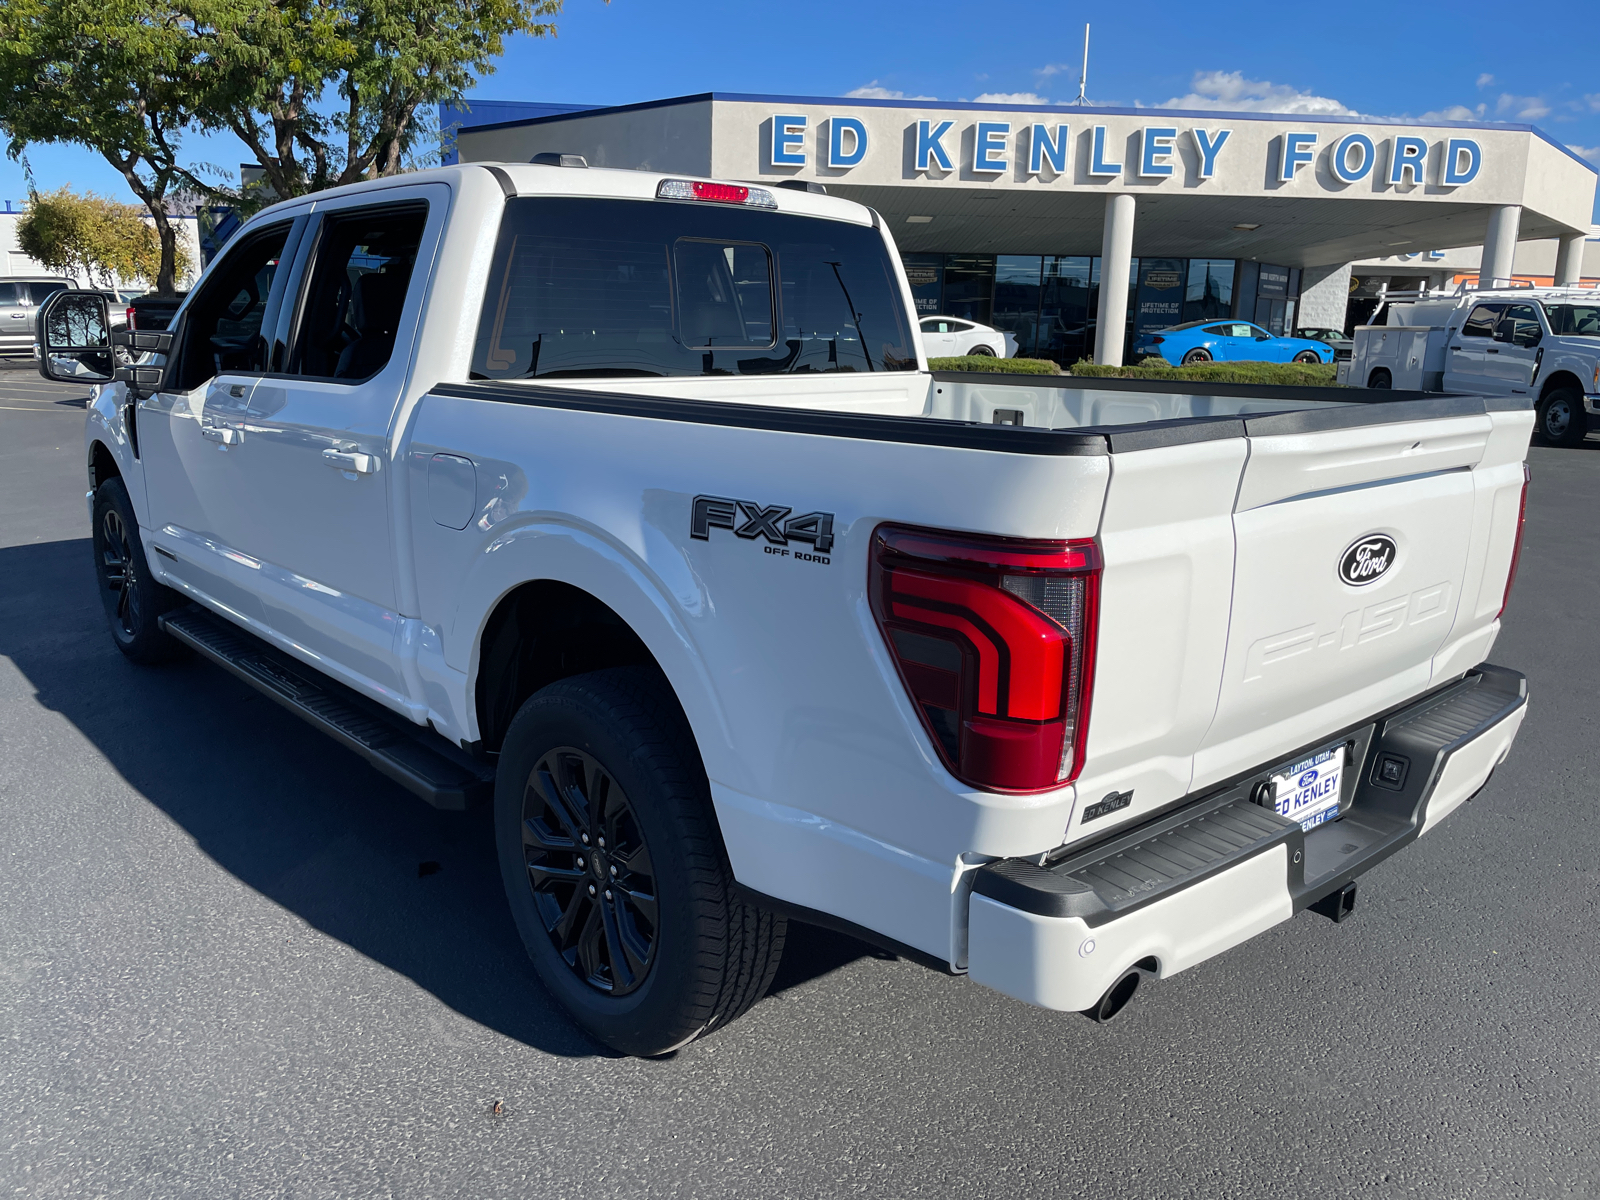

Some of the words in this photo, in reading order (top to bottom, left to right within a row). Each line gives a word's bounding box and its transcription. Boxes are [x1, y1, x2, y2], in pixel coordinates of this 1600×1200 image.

[770, 113, 869, 168] ED
[914, 118, 1234, 179] KENLEY
[1277, 131, 1483, 187] FORD
[690, 493, 836, 554] FX4
[763, 546, 790, 556] OFF
[794, 551, 831, 565] ROAD
[1350, 542, 1390, 579] Ford
[1243, 580, 1453, 683] F-150
[1314, 750, 1330, 765] UTAH
[1083, 808, 1096, 820] ED
[1097, 794, 1133, 815] KENLEY
[1294, 773, 1339, 810] KENLEY
[1300, 811, 1326, 833] ENLEY
